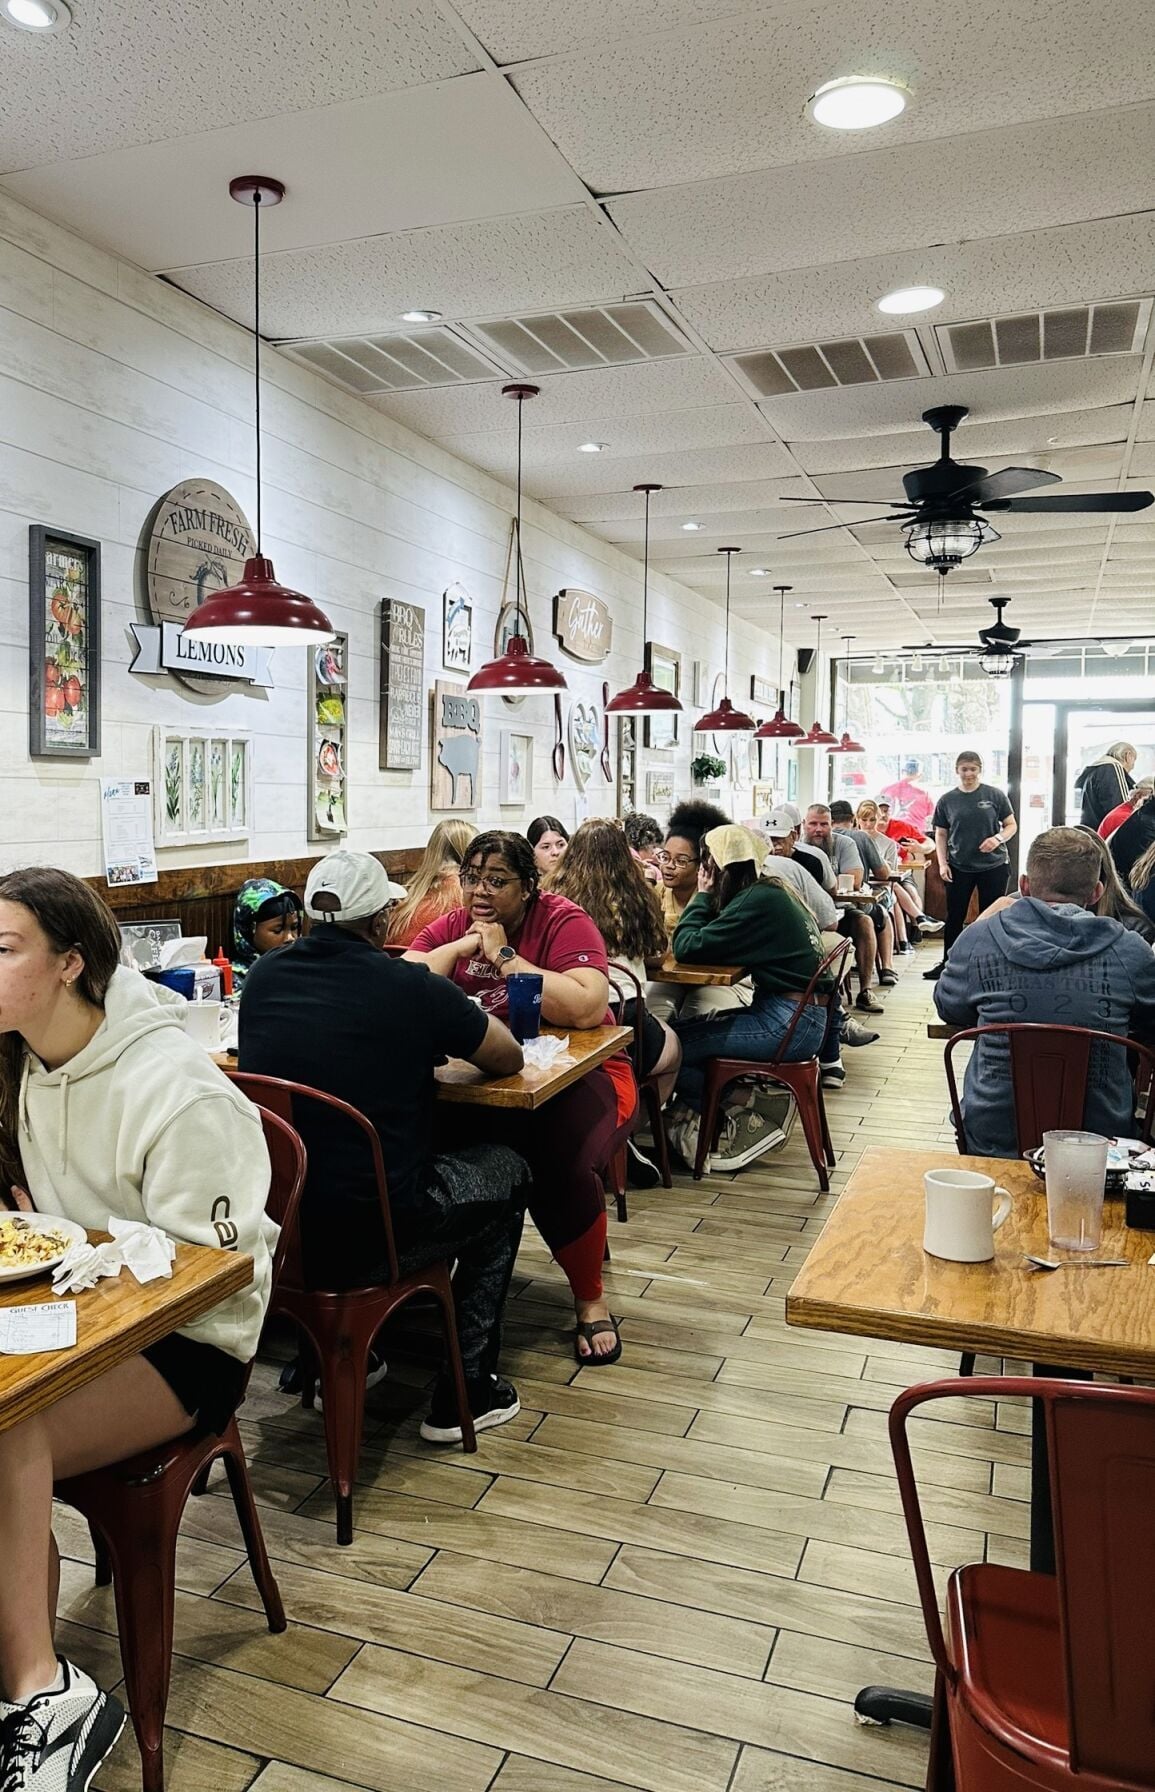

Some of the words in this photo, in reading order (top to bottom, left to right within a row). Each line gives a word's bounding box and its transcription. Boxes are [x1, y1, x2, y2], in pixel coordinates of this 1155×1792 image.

[169, 508, 207, 535] FARM
[209, 511, 249, 557] FRESH
[187, 536, 213, 553] PICKED
[213, 544, 233, 558] DAILY
[568, 596, 604, 640] Gather
[176, 633, 245, 667] LEMONS
[398, 627, 423, 649] RULES
[441, 694, 480, 734] BBQ
[1062, 979, 1112, 996] TOUR
[9, 1306, 37, 1314] GUEST
[41, 1303, 69, 1311] CHECK
